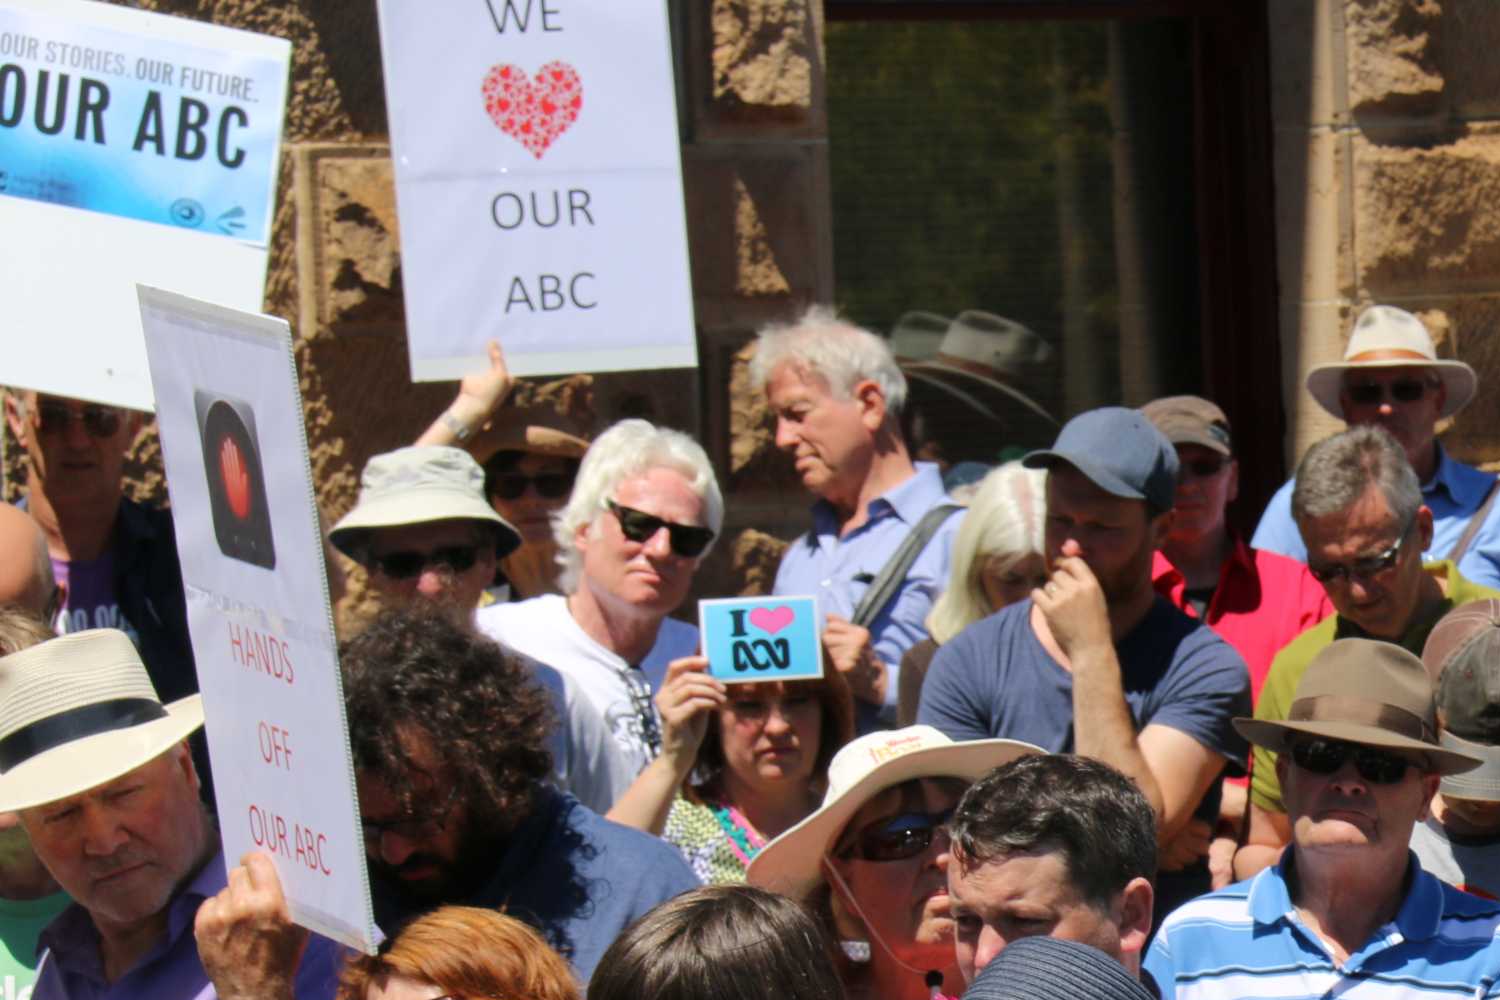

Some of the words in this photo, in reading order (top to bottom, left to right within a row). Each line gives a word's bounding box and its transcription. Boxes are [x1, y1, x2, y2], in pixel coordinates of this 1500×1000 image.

[484, 0, 564, 34] WE
[1, 32, 40, 61] OUR
[45, 40, 131, 79] STORIES.
[135, 57, 174, 86] OUR
[180, 66, 259, 103] FUTURE.
[0, 63, 111, 145] OUR
[132, 89, 249, 169] ABC
[490, 188, 595, 231] OUR
[505, 271, 598, 314] ABC
[729, 608, 749, 637] I
[227, 620, 295, 685] HANDS
[257, 719, 293, 771] OFF
[249, 804, 292, 860] OUR
[295, 823, 332, 877] ABC
